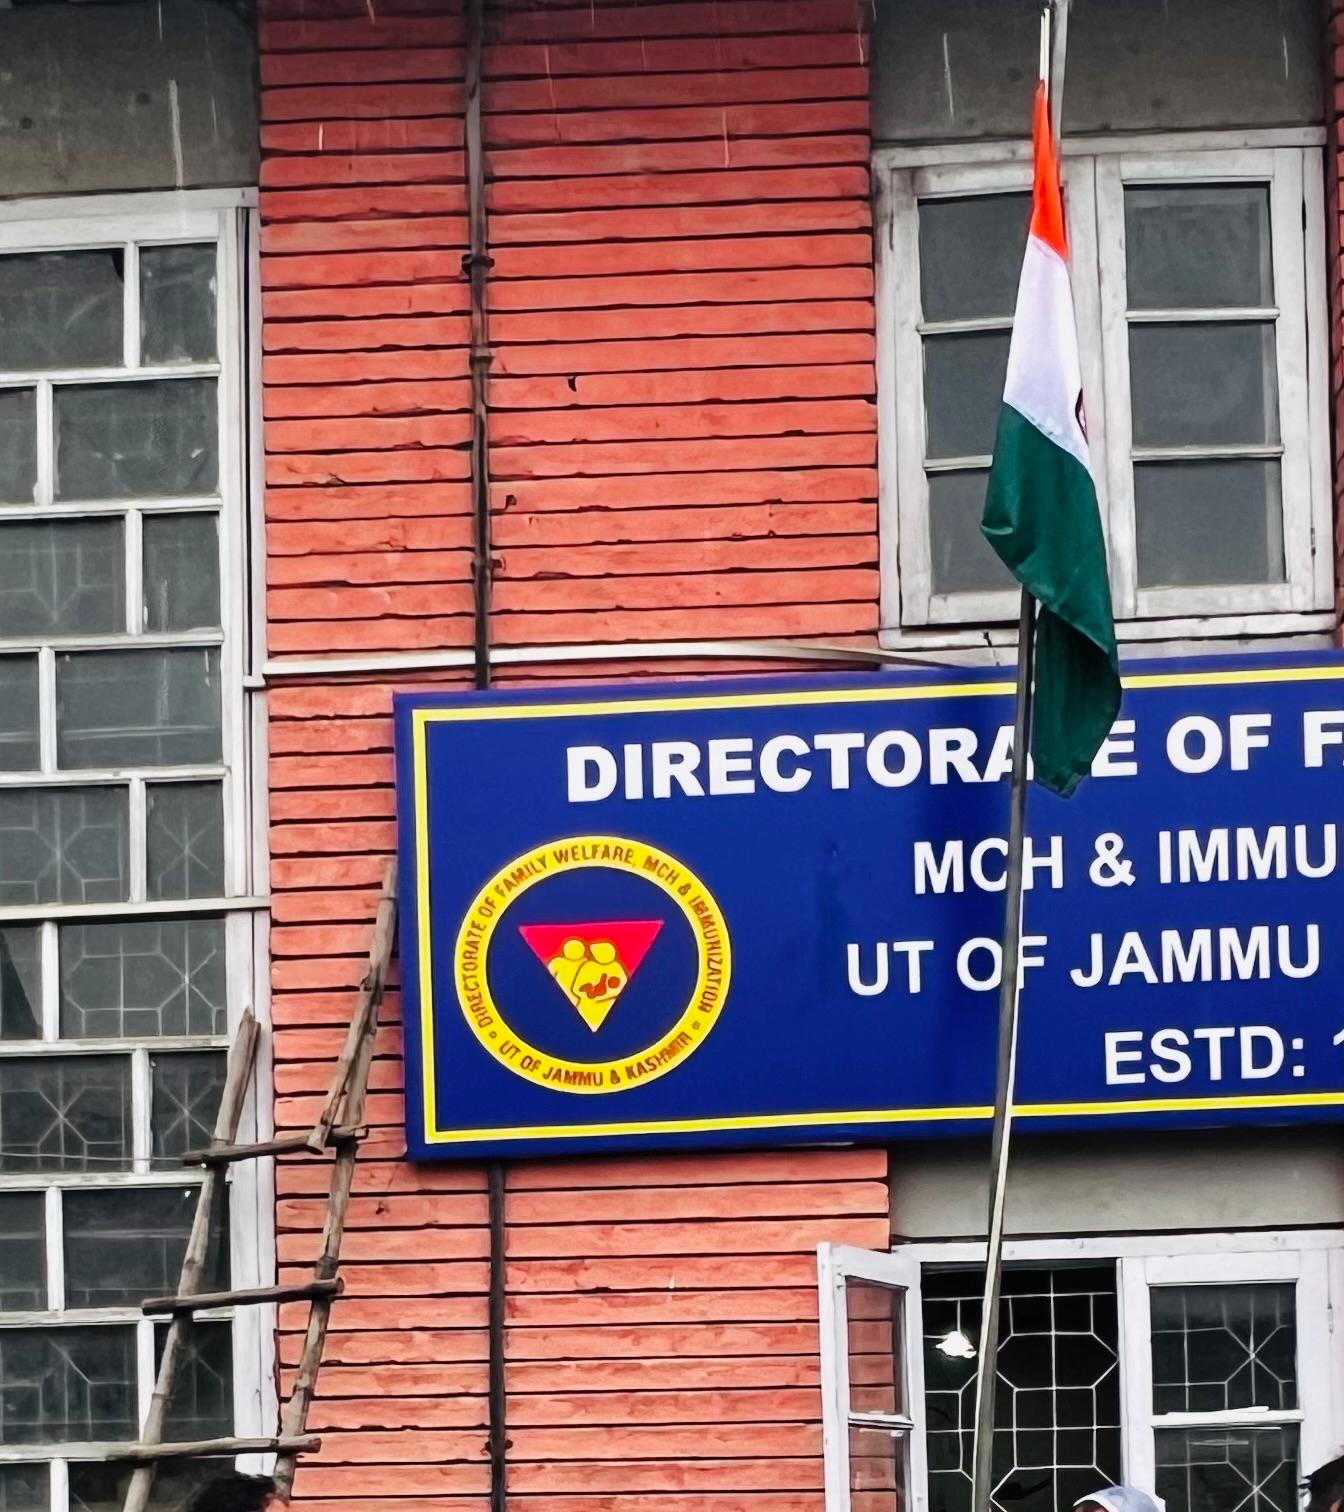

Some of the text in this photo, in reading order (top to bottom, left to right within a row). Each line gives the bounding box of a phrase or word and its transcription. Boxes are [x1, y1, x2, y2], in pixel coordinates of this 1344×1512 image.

[567, 720, 1137, 802] DIRECTORAE
[1167, 714, 1271, 773] OF
[496, 855, 548, 897] FAMILY
[642, 855, 679, 885] MCH
[678, 882, 691, 897] &
[914, 836, 1063, 894] MCH
[1089, 833, 1135, 886] &
[477, 896, 497, 918] OF
[462, 920, 494, 1029] DIRECTORATE
[688, 895, 722, 1013] IMMUNIZATION
[846, 941, 933, 996] UT
[957, 936, 1047, 992] OF
[1071, 922, 1319, 987] JAMMU
[498, 1031, 694, 1086] UT OF JAMMU & KASHMIR
[1105, 1024, 1304, 1084] ESTD:
